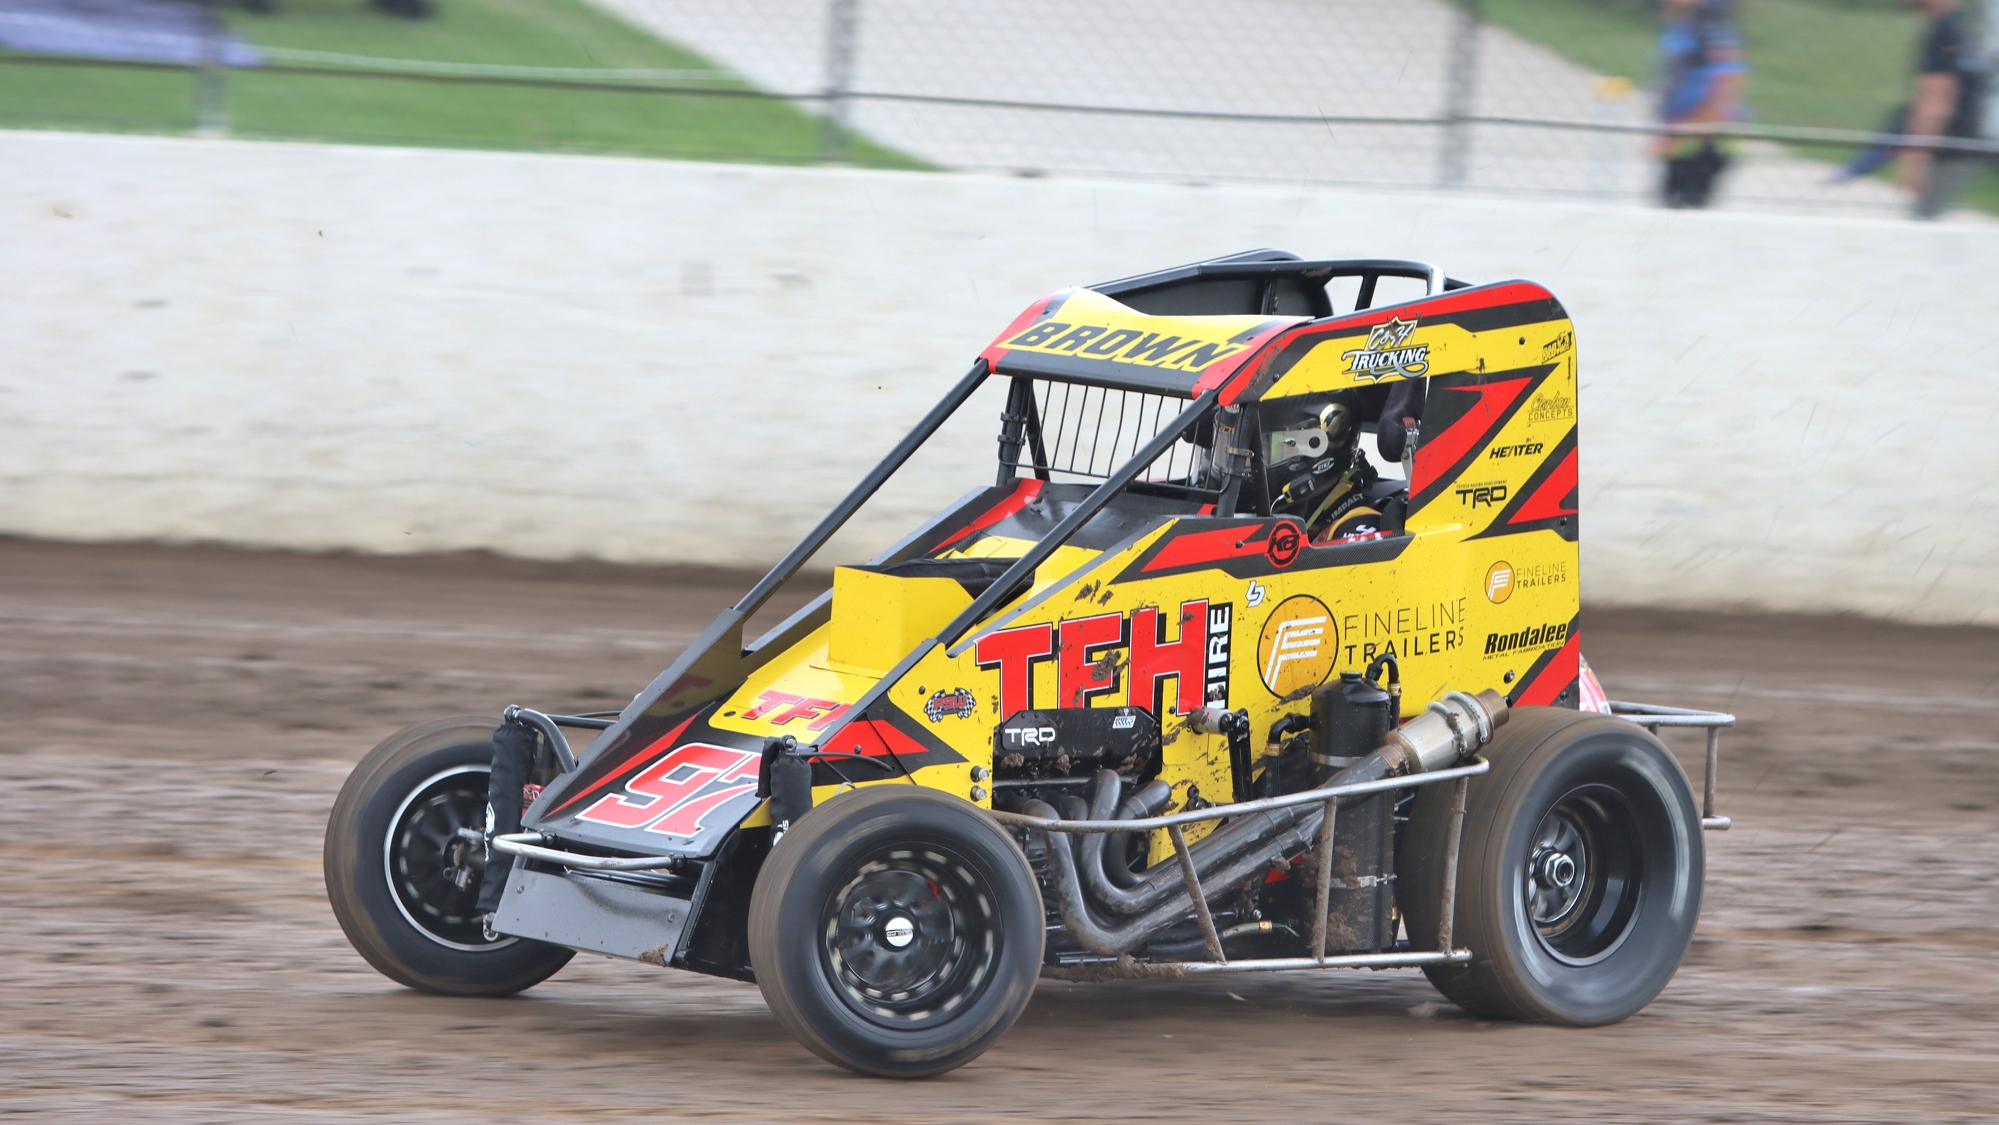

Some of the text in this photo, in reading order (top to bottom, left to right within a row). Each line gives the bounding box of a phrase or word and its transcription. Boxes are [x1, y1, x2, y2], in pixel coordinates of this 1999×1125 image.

[1005, 321, 1242, 370] BROWN
[1341, 347, 1429, 378] TRUCKING
[1528, 408, 1573, 421] CONCEPTS
[1330, 492, 1365, 521] IMPACT
[1456, 485, 1507, 509] TRD
[1516, 561, 1567, 579] FINELINE
[1516, 573, 1567, 589] TRAILERS
[1344, 597, 1467, 640] FINELINE
[1344, 626, 1464, 665] TRAILERS
[1484, 622, 1567, 655] Rondalee
[973, 598, 1210, 724] TFH
[1483, 651, 1509, 661] METAL
[933, 695, 967, 711] PSW
[1004, 727, 1056, 746] TRD
[575, 742, 763, 838] 97
